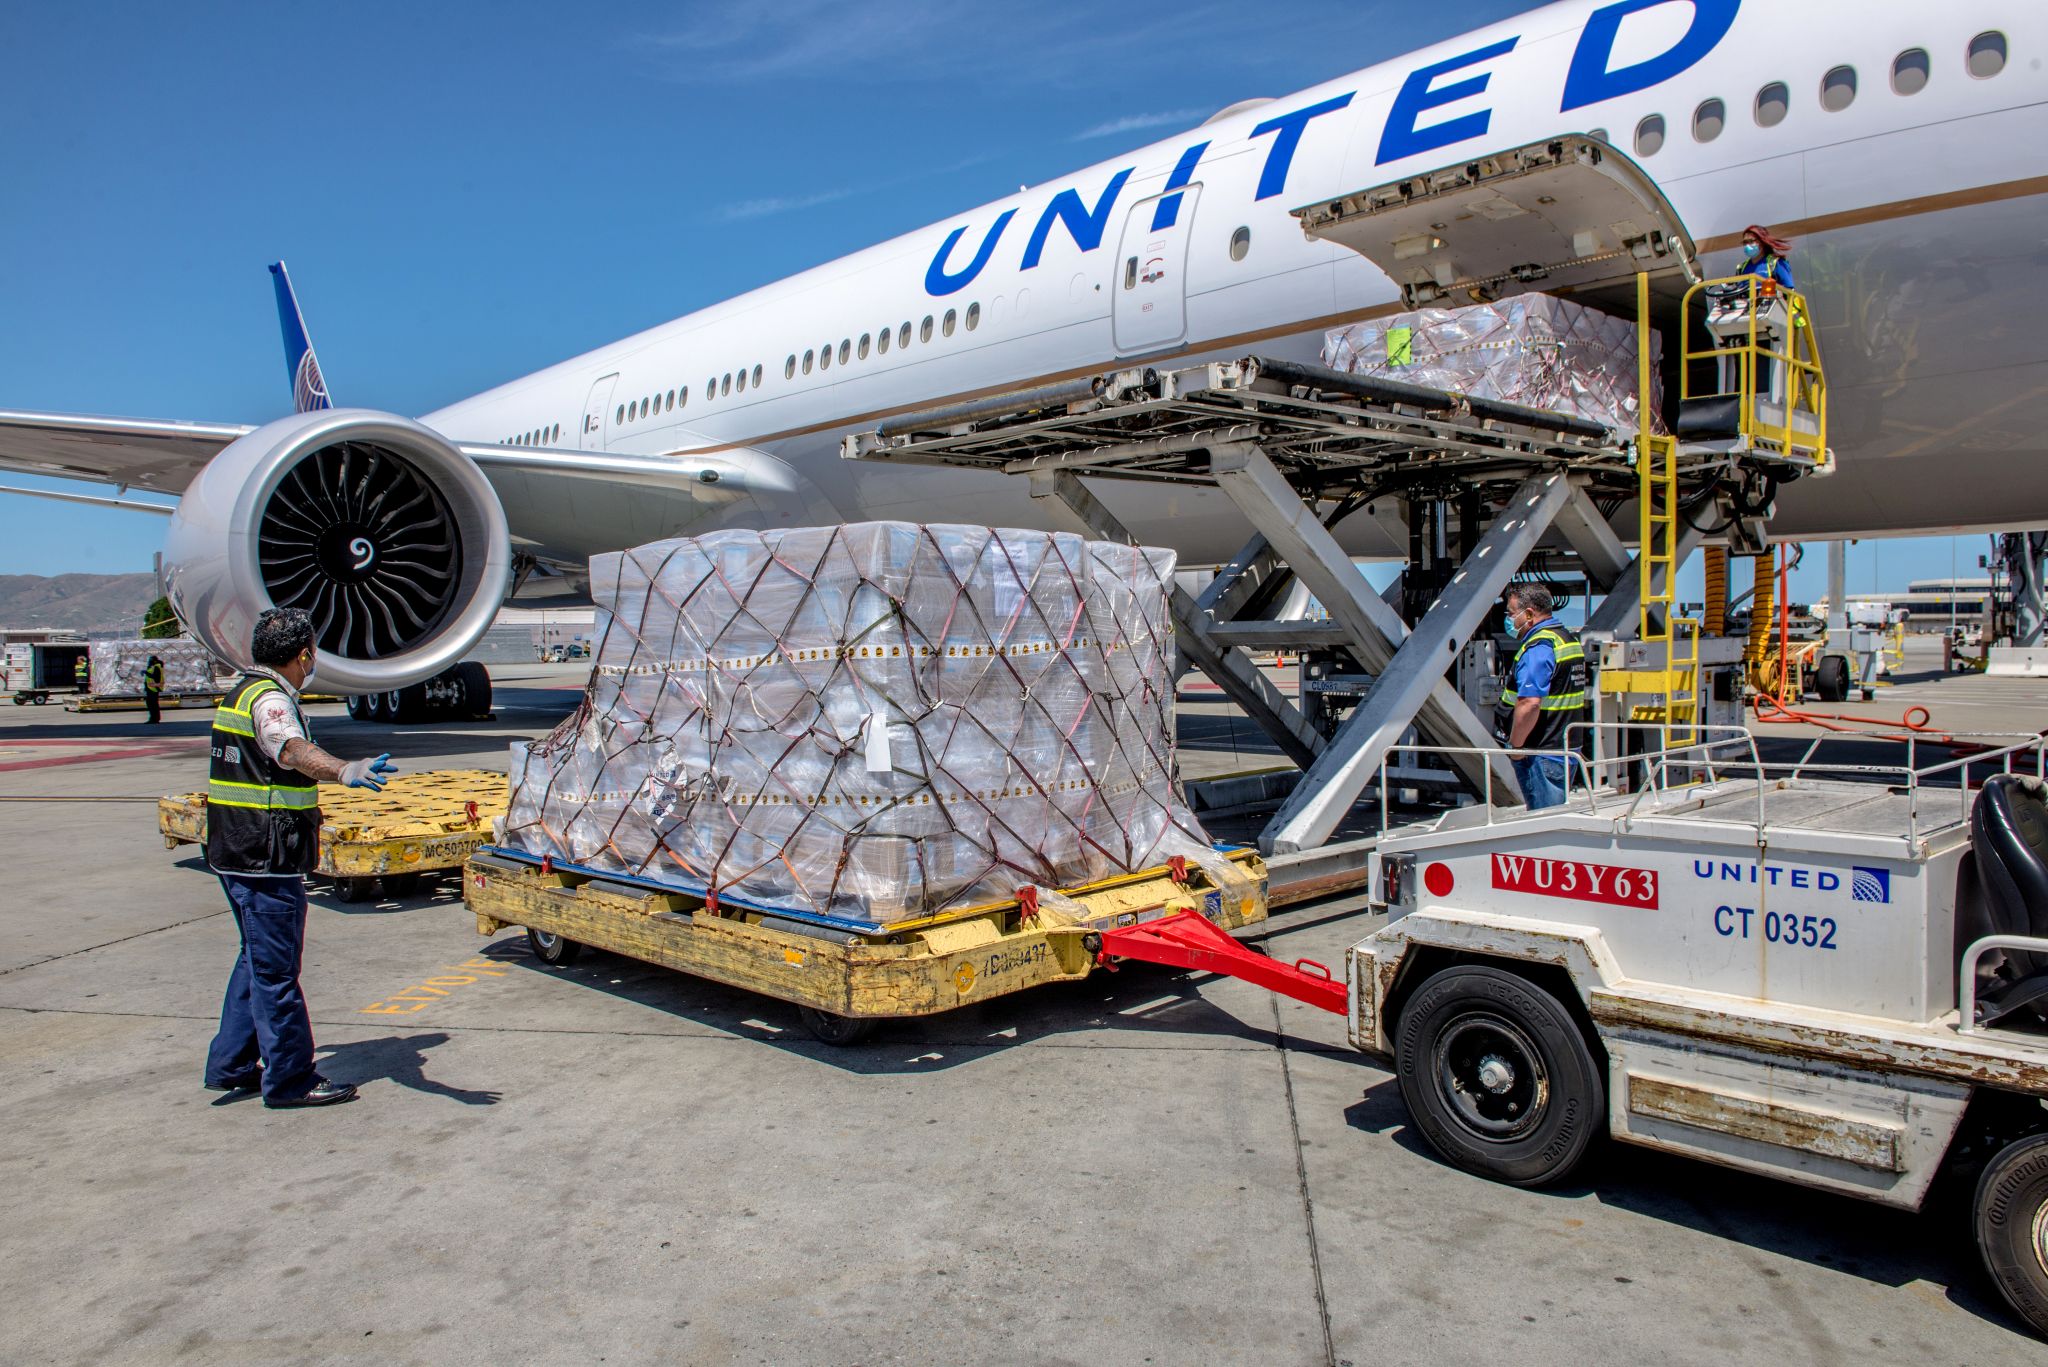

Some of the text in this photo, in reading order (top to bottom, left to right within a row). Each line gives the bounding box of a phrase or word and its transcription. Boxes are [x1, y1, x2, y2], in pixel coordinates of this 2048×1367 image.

[924, 0, 1742, 297] UNITED
[1495, 854, 1656, 902] WU3Y63
[1693, 859, 1841, 892] UNITED
[1713, 905, 1838, 950] CT 0352
[1487, 982, 1553, 1031] VELOCITY
